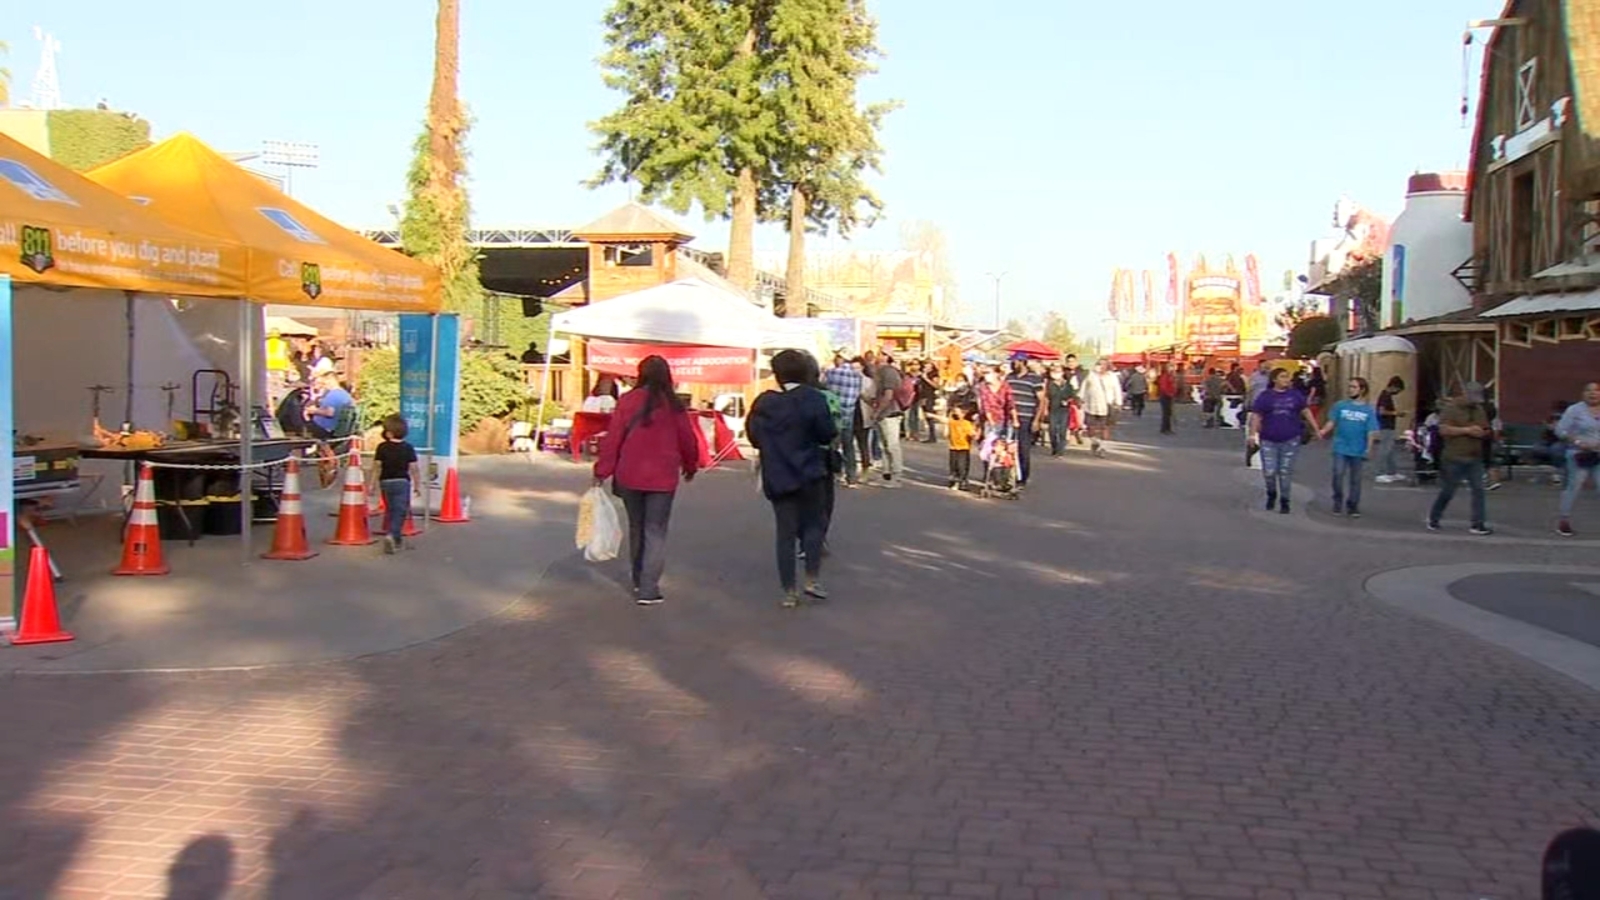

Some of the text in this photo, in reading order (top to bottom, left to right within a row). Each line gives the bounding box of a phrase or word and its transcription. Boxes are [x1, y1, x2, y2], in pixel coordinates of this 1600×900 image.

[0, 222, 219, 271] all 811 before you dig and plant
[591, 355, 623, 366] SOCIAL
[693, 356, 750, 366] ASSOCIATION
